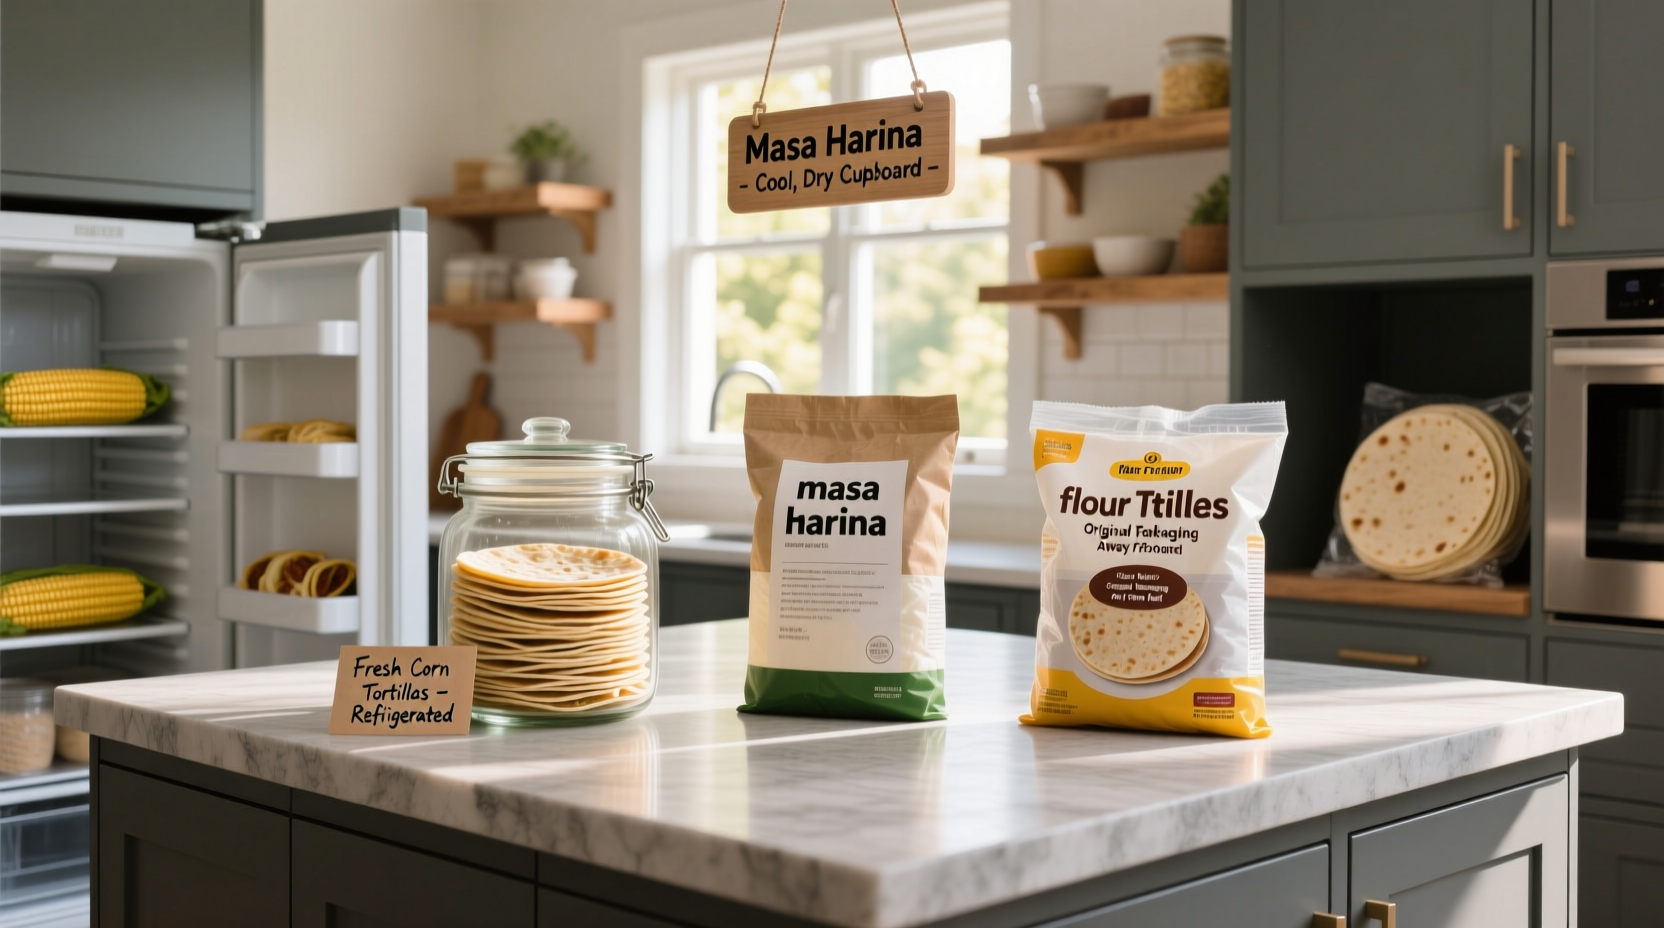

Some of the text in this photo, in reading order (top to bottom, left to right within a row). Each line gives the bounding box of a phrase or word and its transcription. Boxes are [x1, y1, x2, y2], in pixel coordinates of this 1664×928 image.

[745, 118, 922, 165] Masa Harina
[755, 169, 798, 194] Cool,
[803, 168, 834, 192] Dry
[840, 156, 922, 188] Cupboard
[797, 481, 880, 501] masa
[1059, 485, 1229, 520] flour Ttilles
[785, 505, 886, 536] harina
[353, 655, 449, 678] Fresh Corn
[362, 682, 429, 701] Tortillas
